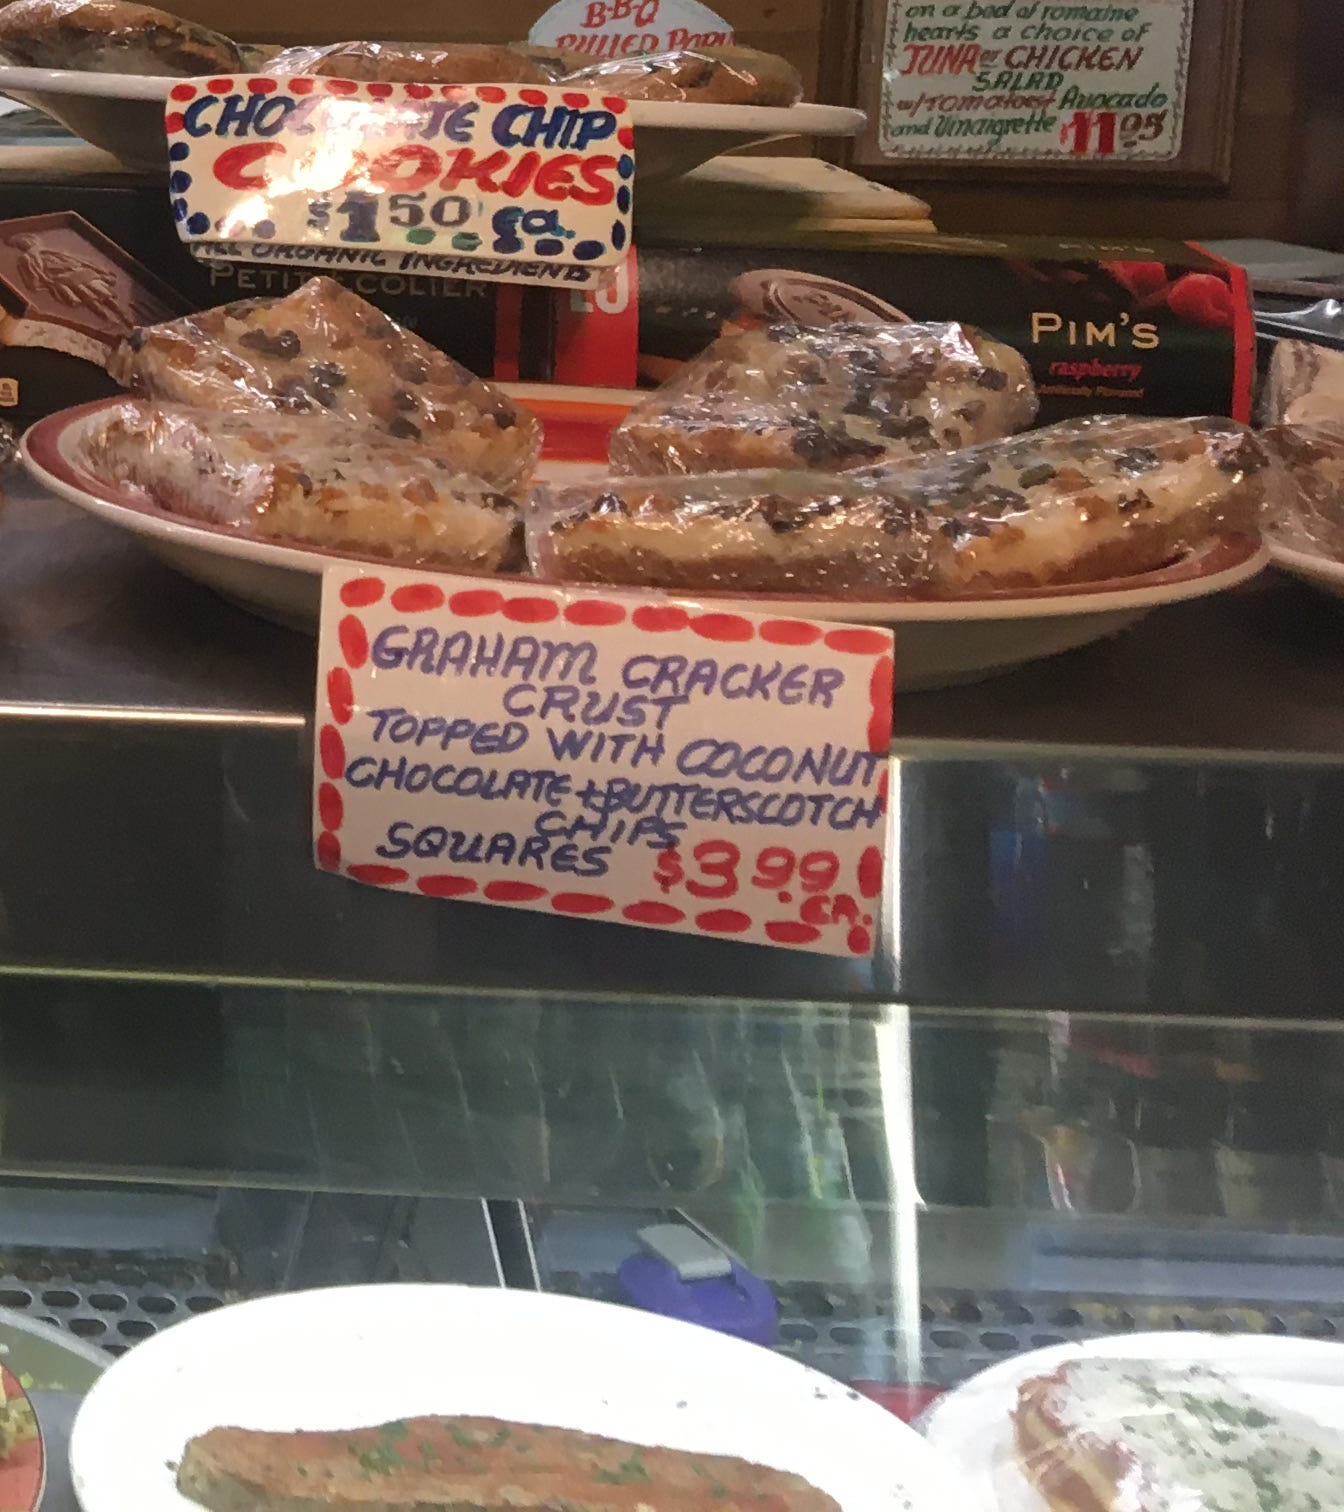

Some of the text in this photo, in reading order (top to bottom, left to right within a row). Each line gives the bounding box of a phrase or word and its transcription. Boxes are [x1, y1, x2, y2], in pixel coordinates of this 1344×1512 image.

[972, 70, 1066, 93] SALAD
[1004, 44, 1145, 73] CHICKEN
[488, 101, 619, 152] CHIP
[1028, 311, 1160, 351] PIM'S
[370, 624, 847, 710] GRAHAM CRACKER
[500, 684, 694, 732] CRUST
[364, 706, 880, 792] TOPPED WITH COCONUT
[342, 756, 574, 809] CHOCOLATE
[374, 820, 614, 881] SQUARES
[532, 808, 692, 854] CHIPS
